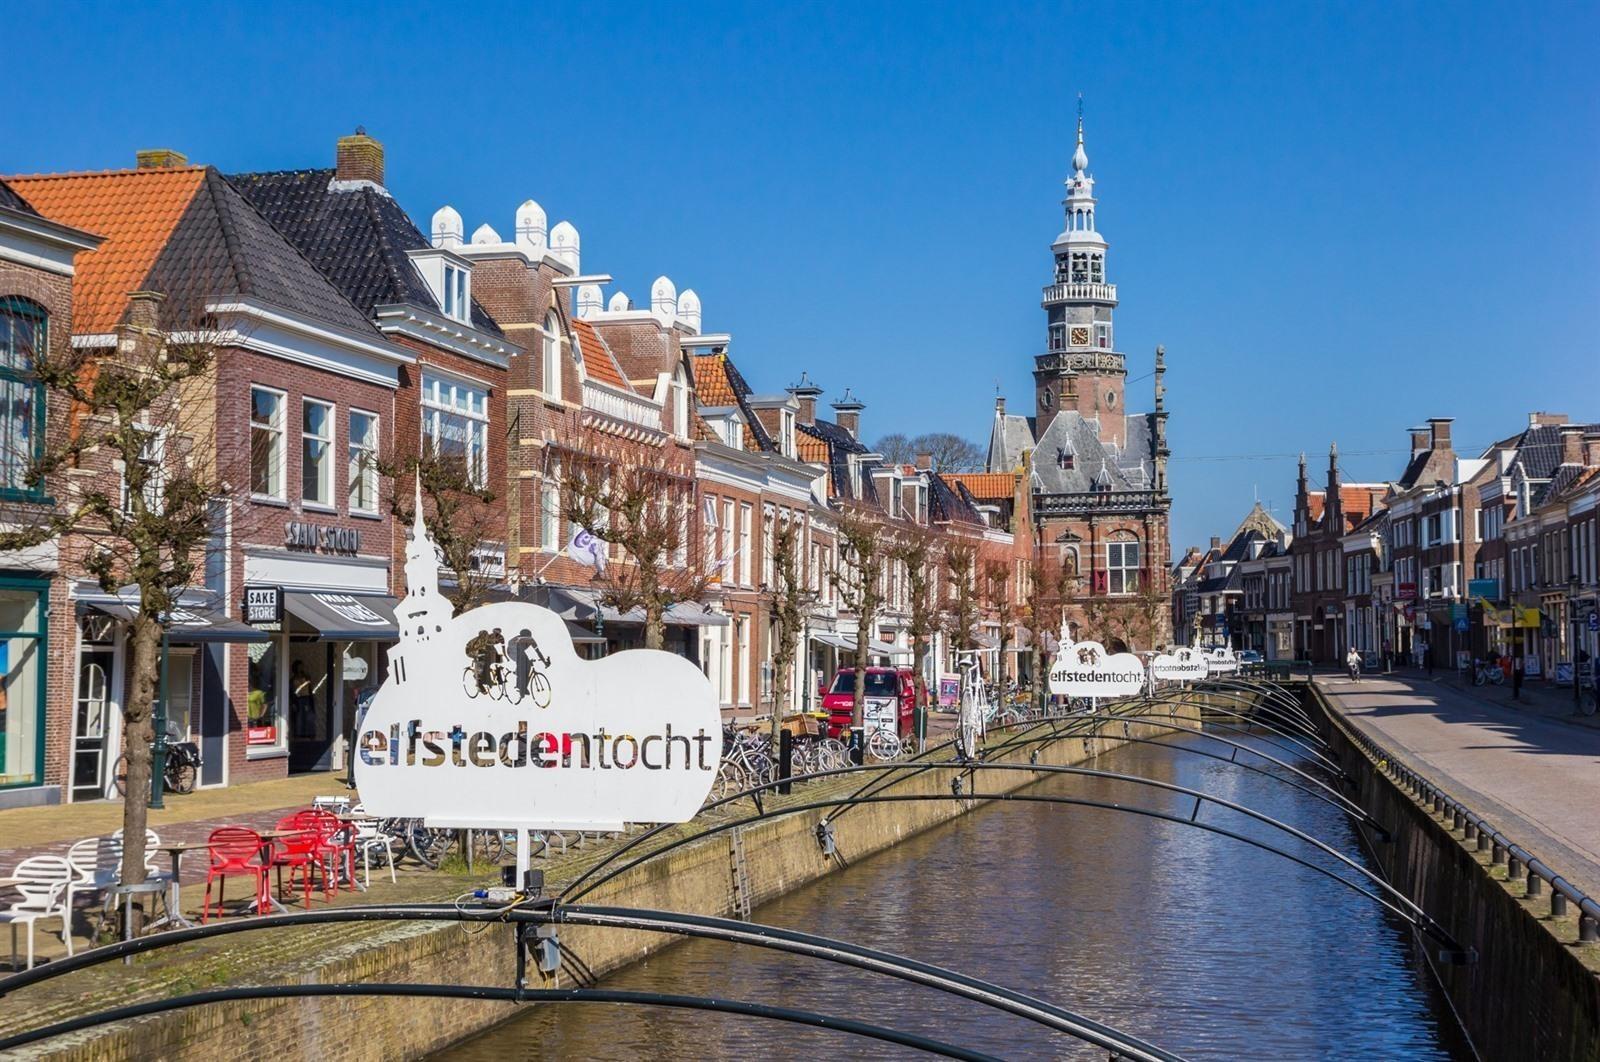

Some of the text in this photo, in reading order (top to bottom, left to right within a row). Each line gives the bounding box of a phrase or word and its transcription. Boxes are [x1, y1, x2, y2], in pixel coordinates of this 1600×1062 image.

[249, 591, 275, 604] SAKE
[248, 606, 275, 619] STORE
[1589, 613, 1597, 623] P
[1050, 670, 1142, 683] elfstedentocht
[359, 719, 712, 771] elfstedentocht
